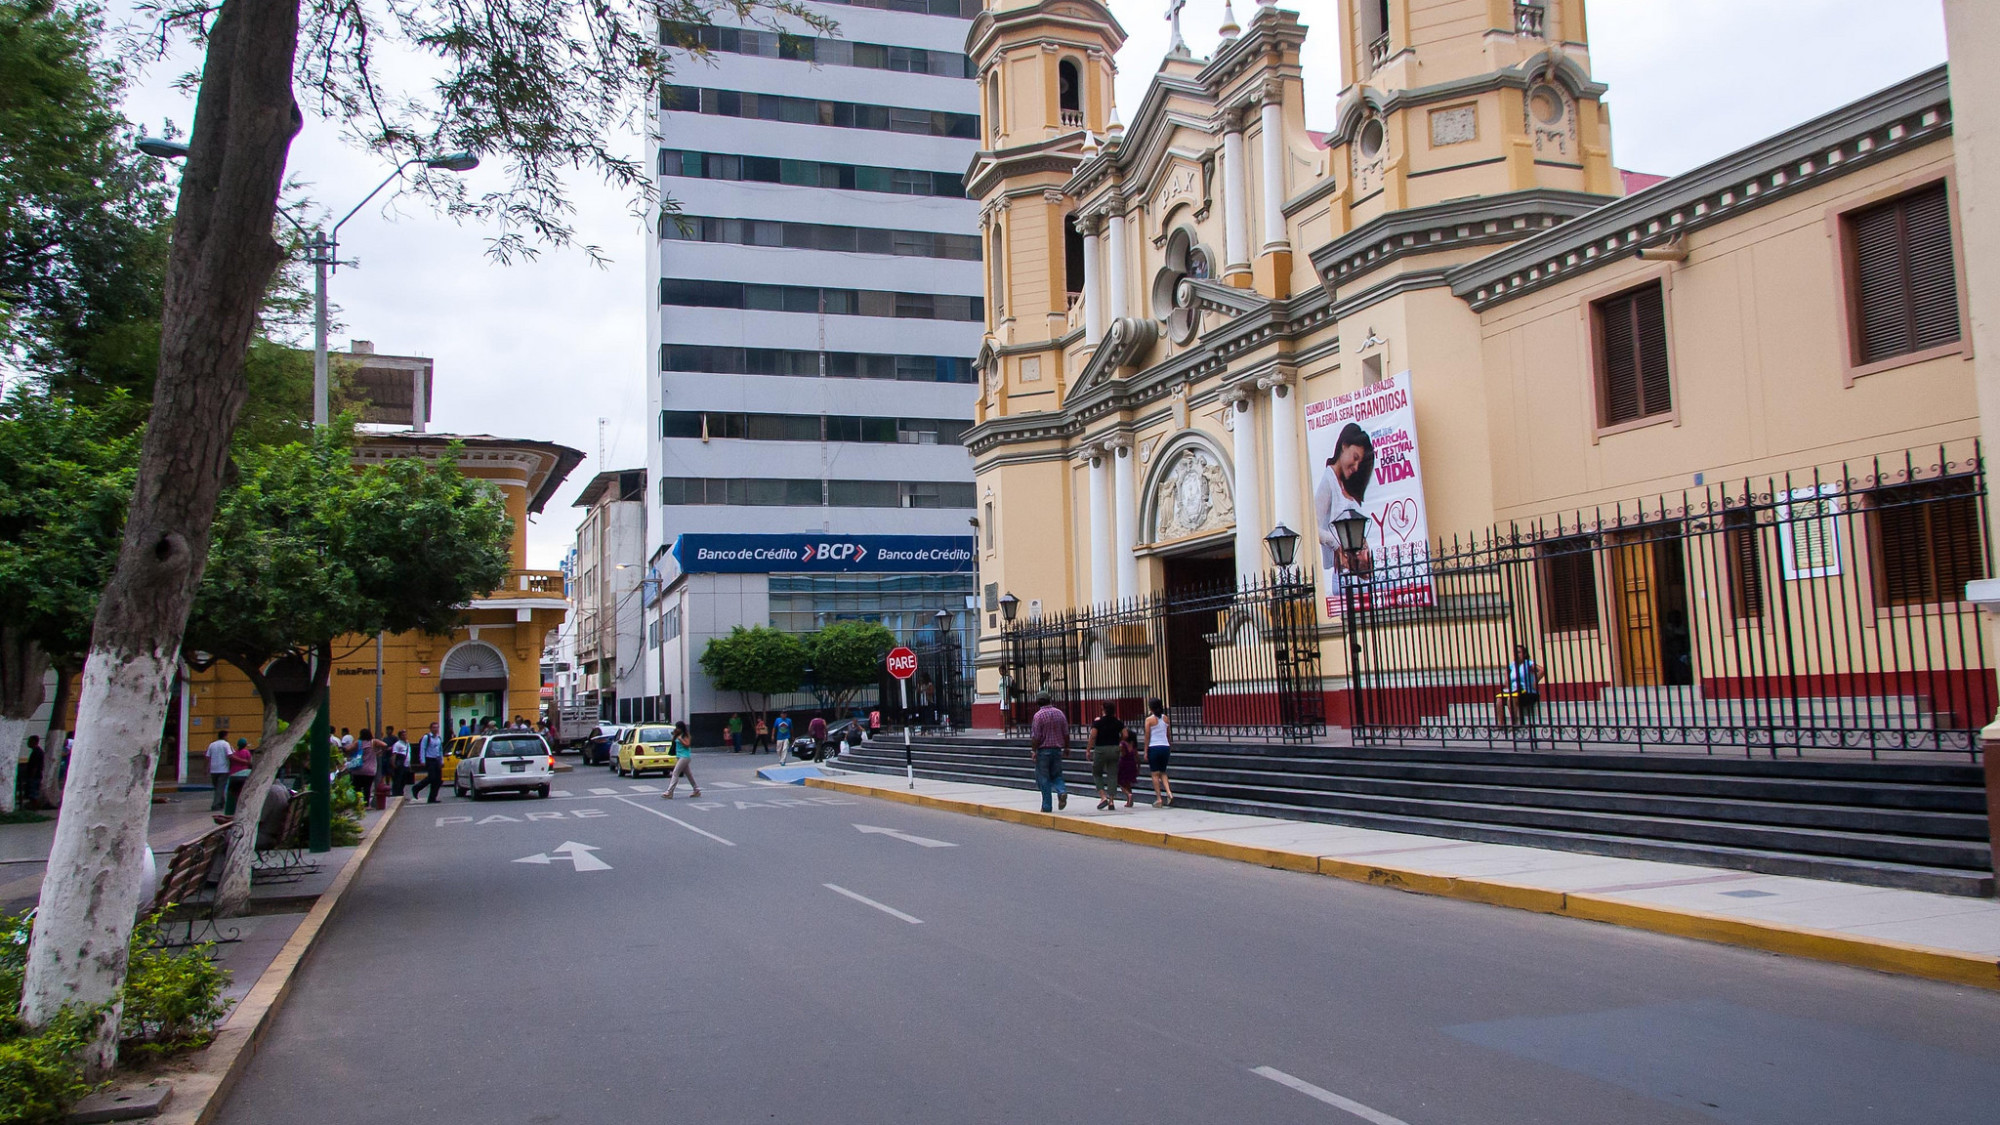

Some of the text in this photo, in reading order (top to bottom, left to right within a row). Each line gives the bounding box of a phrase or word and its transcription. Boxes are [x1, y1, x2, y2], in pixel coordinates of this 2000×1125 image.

[1305, 377, 1395, 416] CUANDO LO TENGAS EN TUS BRAZOS
[1307, 419, 1316, 431] TU
[1354, 388, 1408, 422] GRANDIOSA
[1371, 428, 1408, 448] MARCHA
[1374, 440, 1414, 459] Y FESTIVAL
[1380, 452, 1406, 469] POR LA
[1374, 460, 1415, 486] VIDA
[697, 543, 971, 560] Banco de Crédito BCP Banco de Crédito
[889, 655, 915, 670] PARE
[687, 797, 857, 811] PARE
[435, 808, 609, 828] PARE
